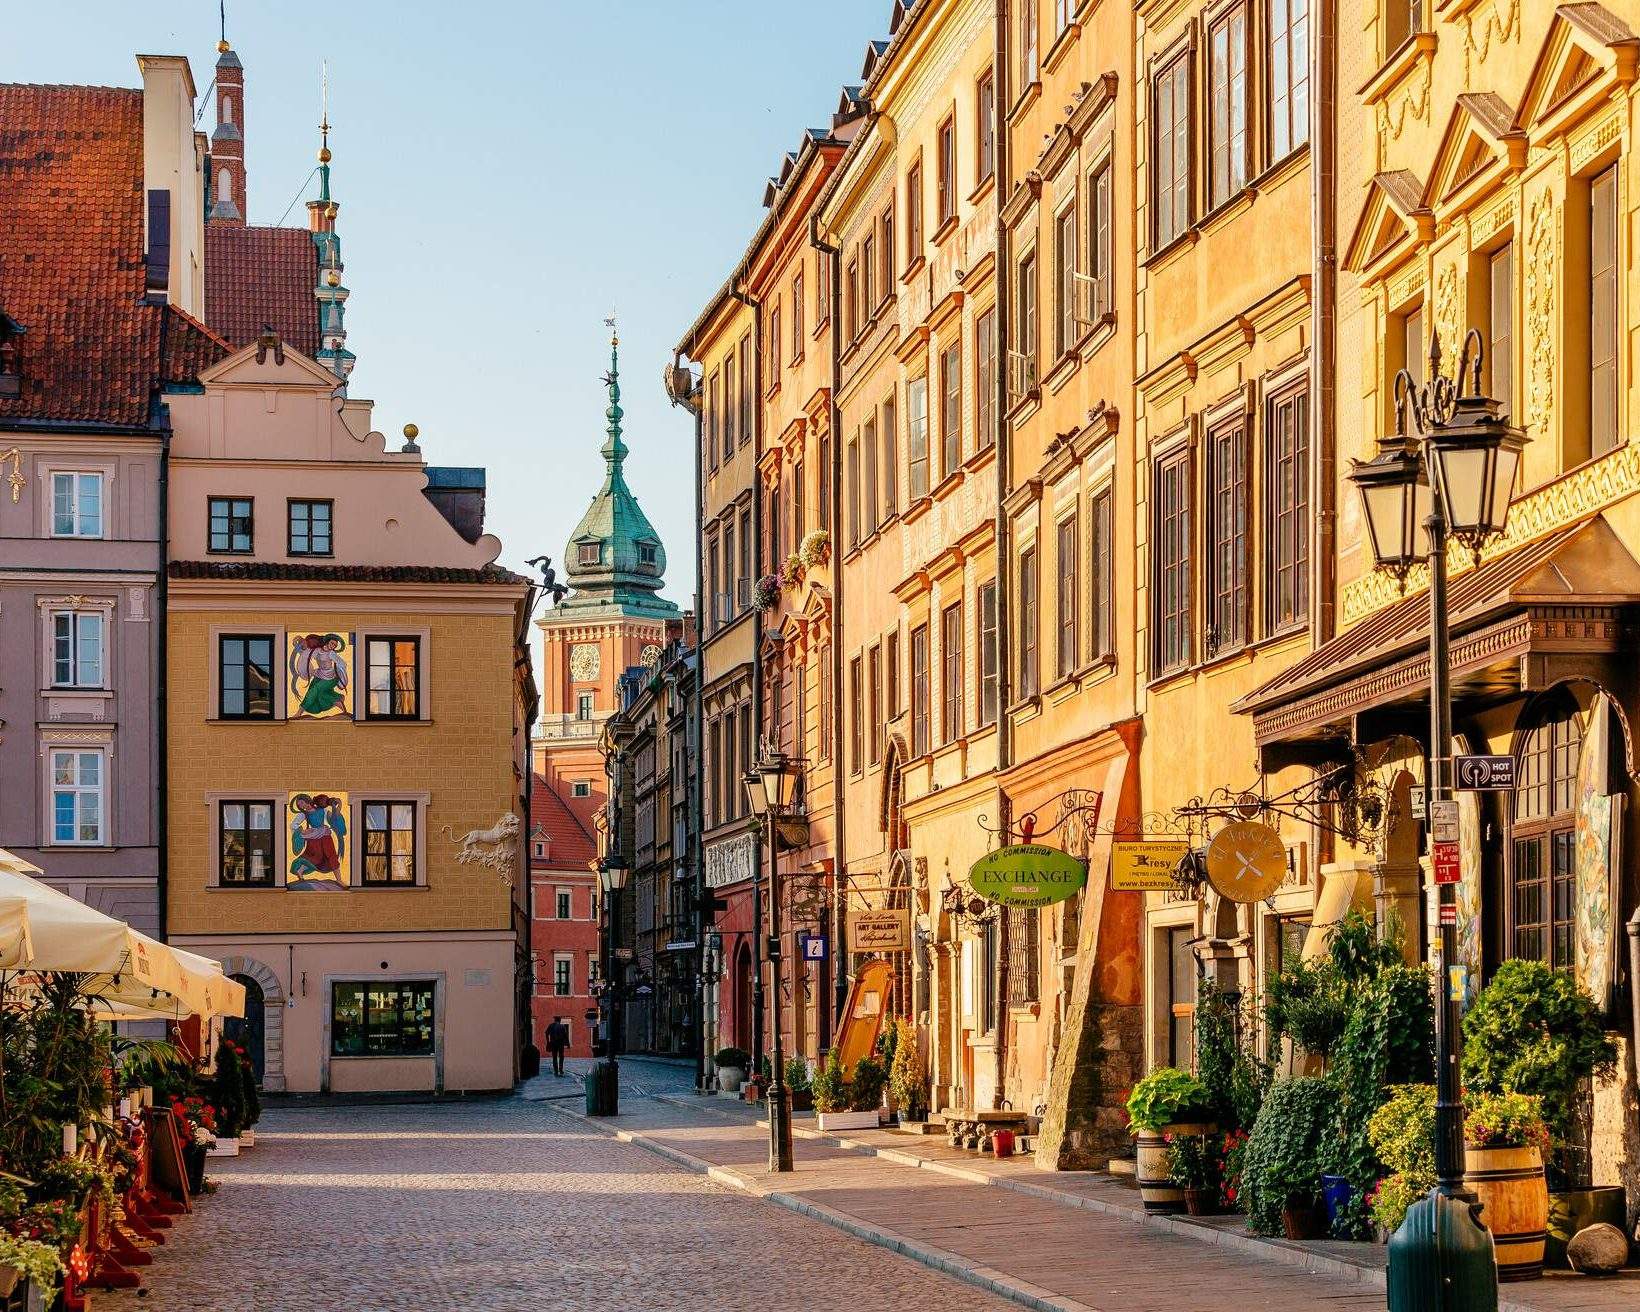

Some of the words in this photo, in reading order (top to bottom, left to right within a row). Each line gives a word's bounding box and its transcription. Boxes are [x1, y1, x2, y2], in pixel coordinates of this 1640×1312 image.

[1491, 774, 1512, 782] SPOT
[1418, 791, 1424, 804] 2
[988, 854, 999, 864] NO
[1003, 847, 1052, 857] COMMISSION
[983, 870, 1072, 883] EXCHANGE
[988, 890, 1000, 900] NO
[1004, 896, 1052, 907] COMMISSION
